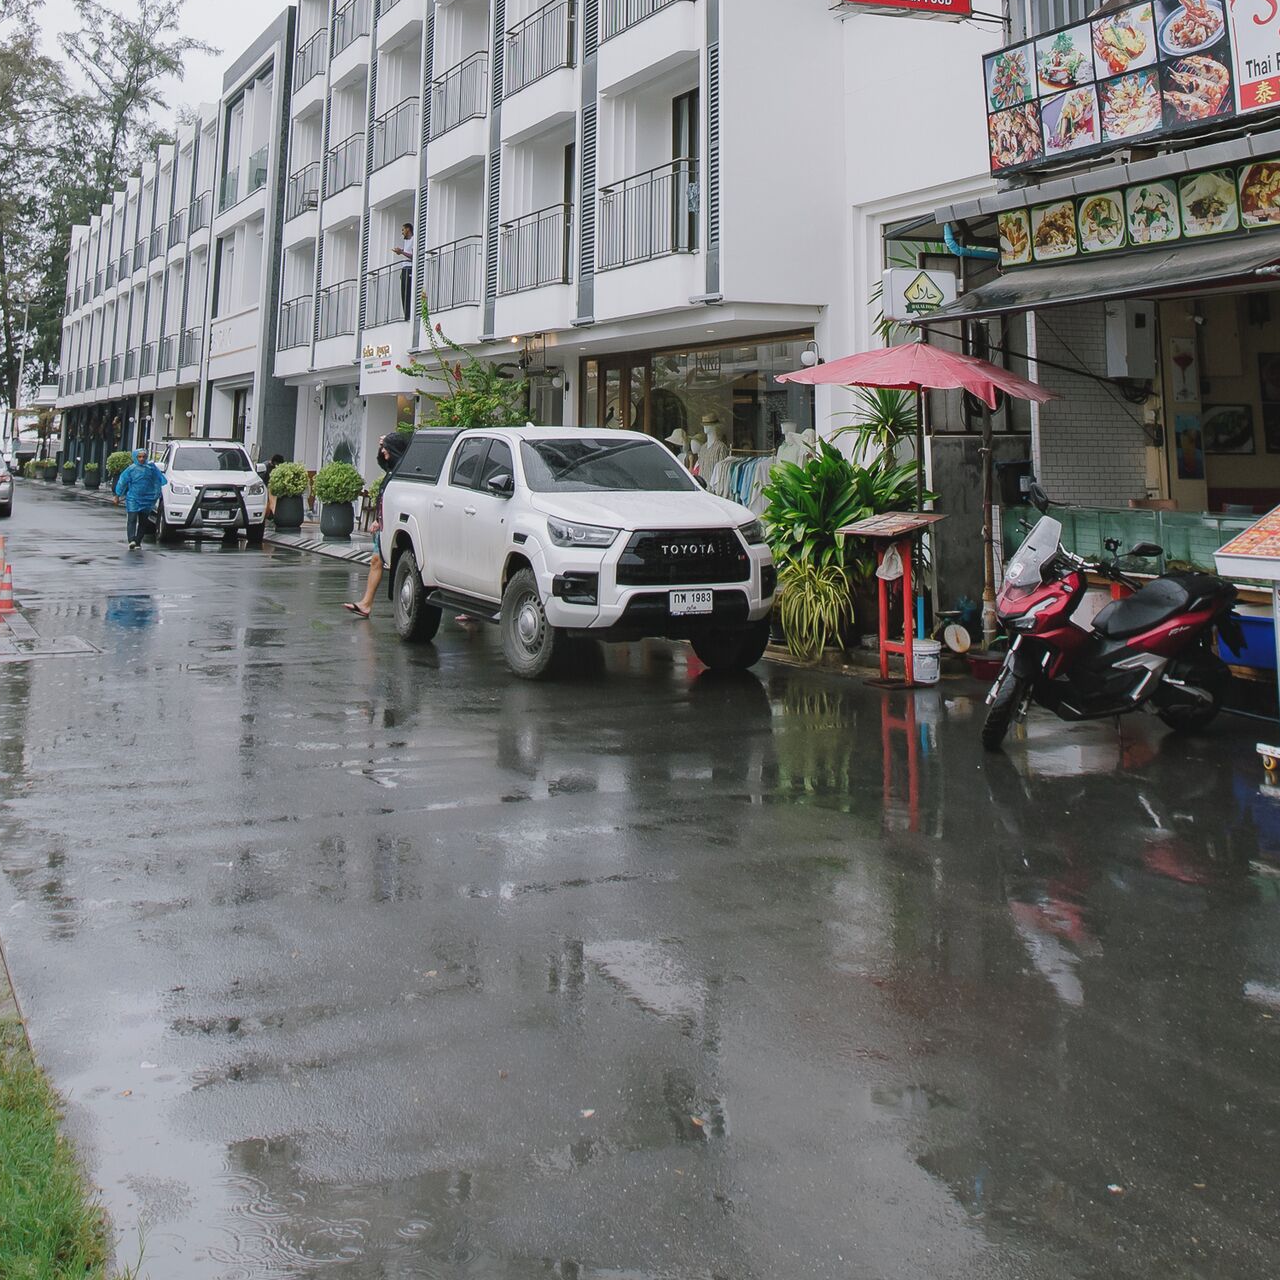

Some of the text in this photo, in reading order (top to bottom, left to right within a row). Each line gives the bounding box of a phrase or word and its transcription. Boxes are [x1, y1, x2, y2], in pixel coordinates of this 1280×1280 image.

[1245, 55, 1272, 79] Thai
[661, 543, 716, 555] TOYOTA
[691, 592, 712, 603] 1983
